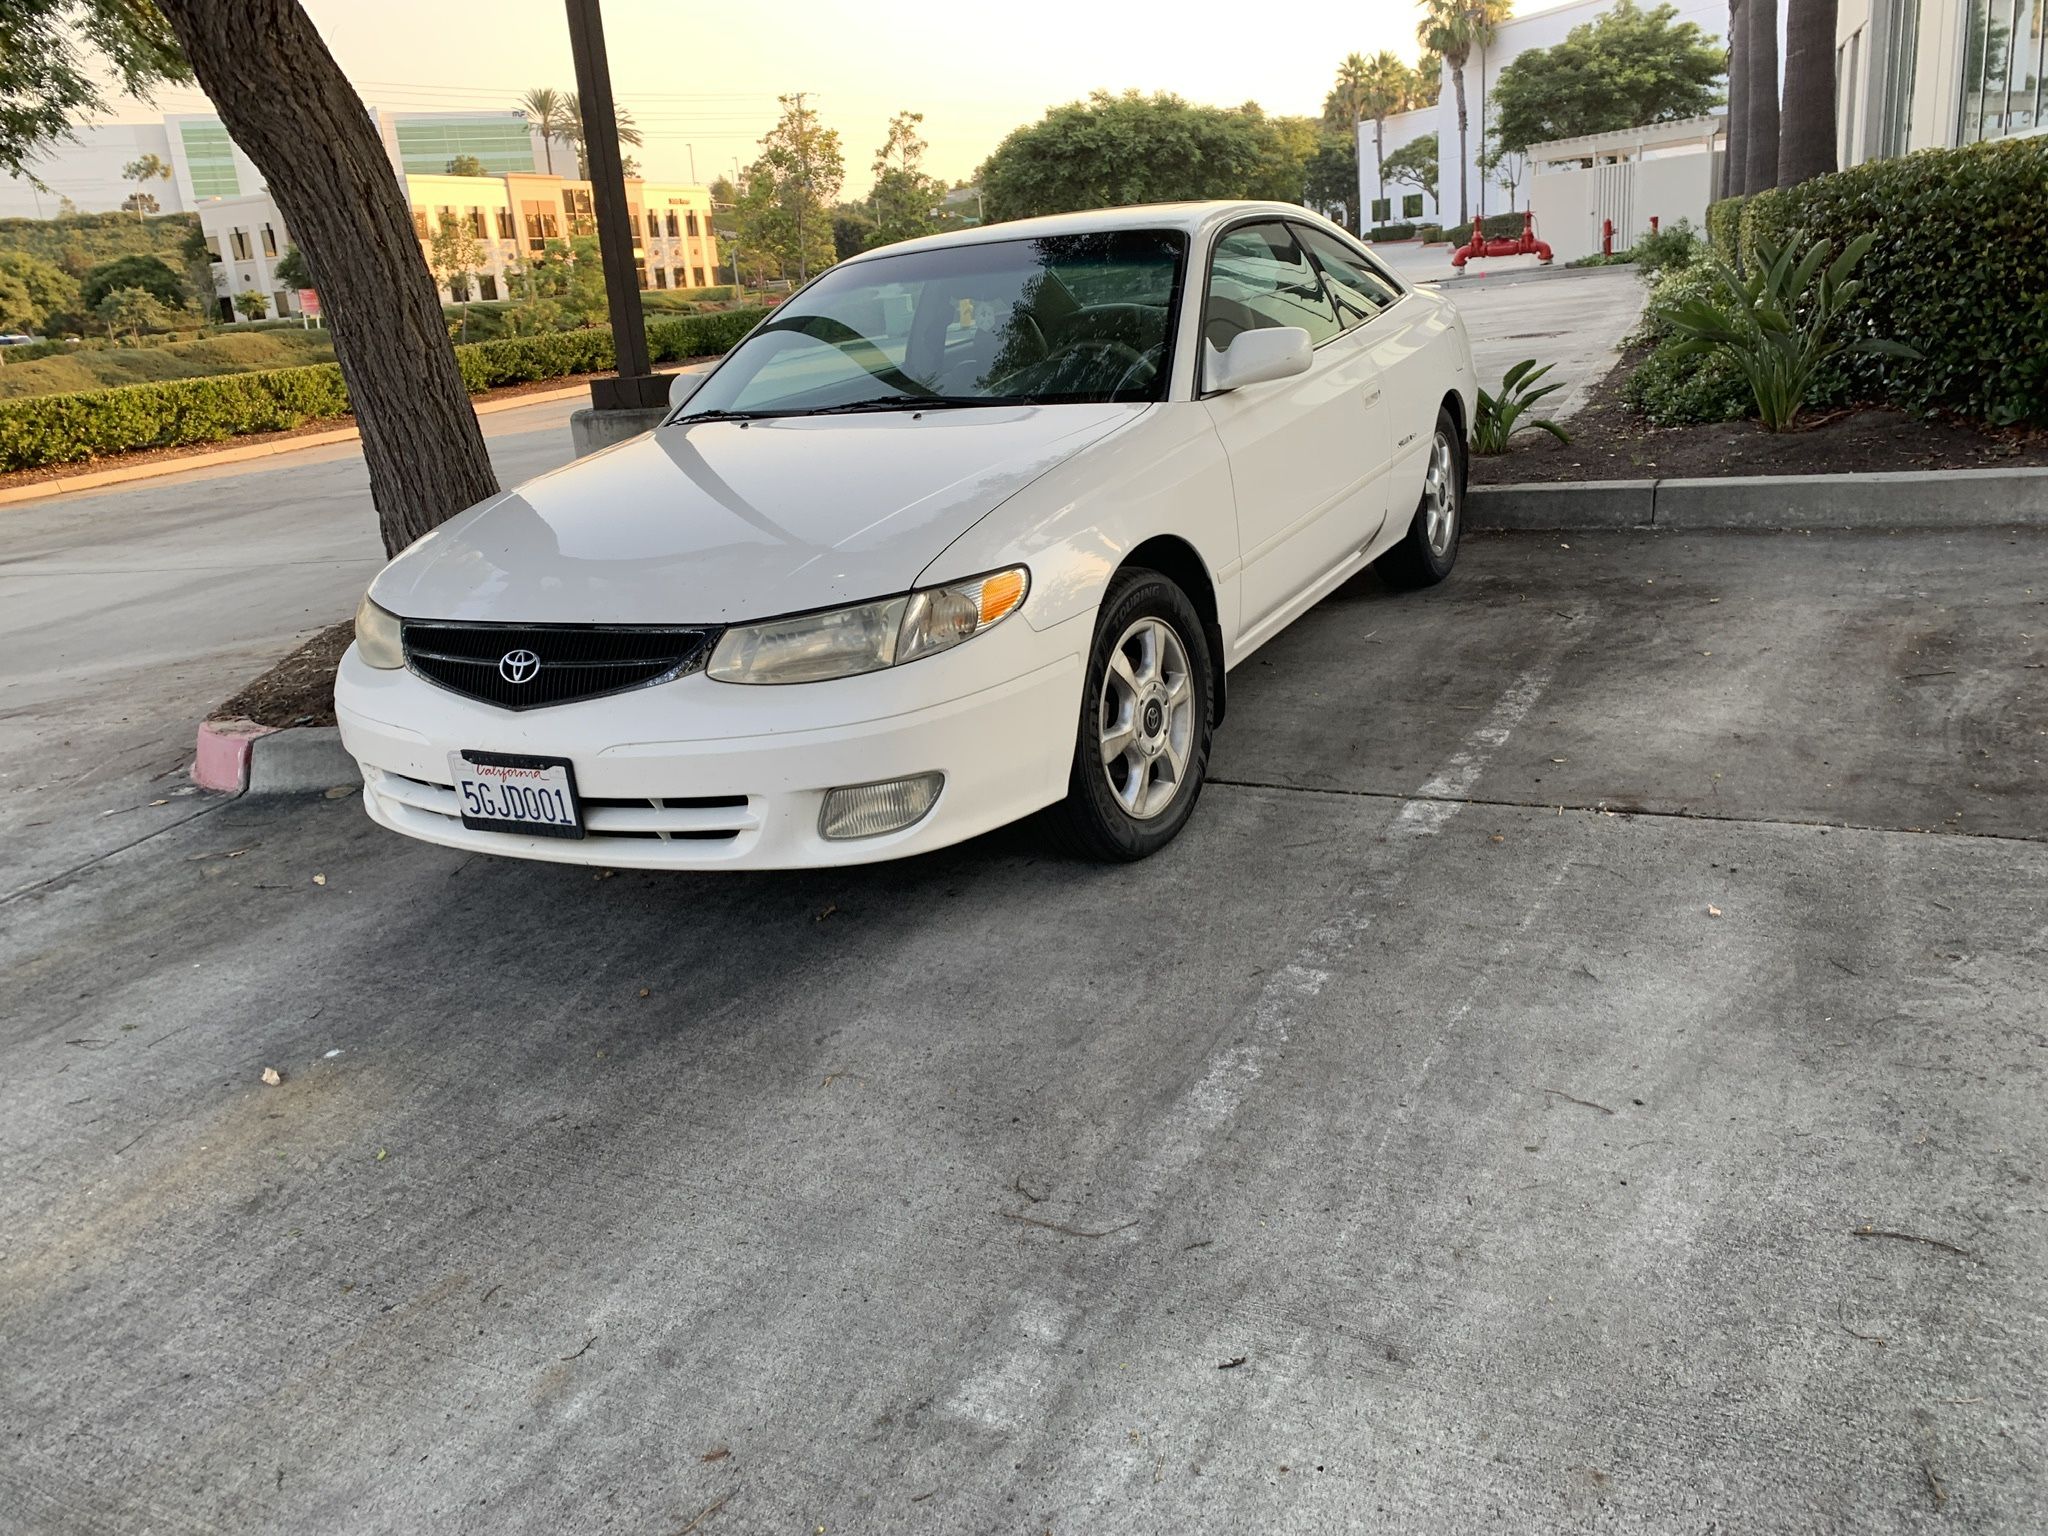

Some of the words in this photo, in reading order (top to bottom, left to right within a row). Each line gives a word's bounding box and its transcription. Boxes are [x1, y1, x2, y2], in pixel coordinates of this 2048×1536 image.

[1113, 585, 1160, 629] TOURING
[476, 764, 549, 783] California
[461, 780, 573, 825] 5GJD001
